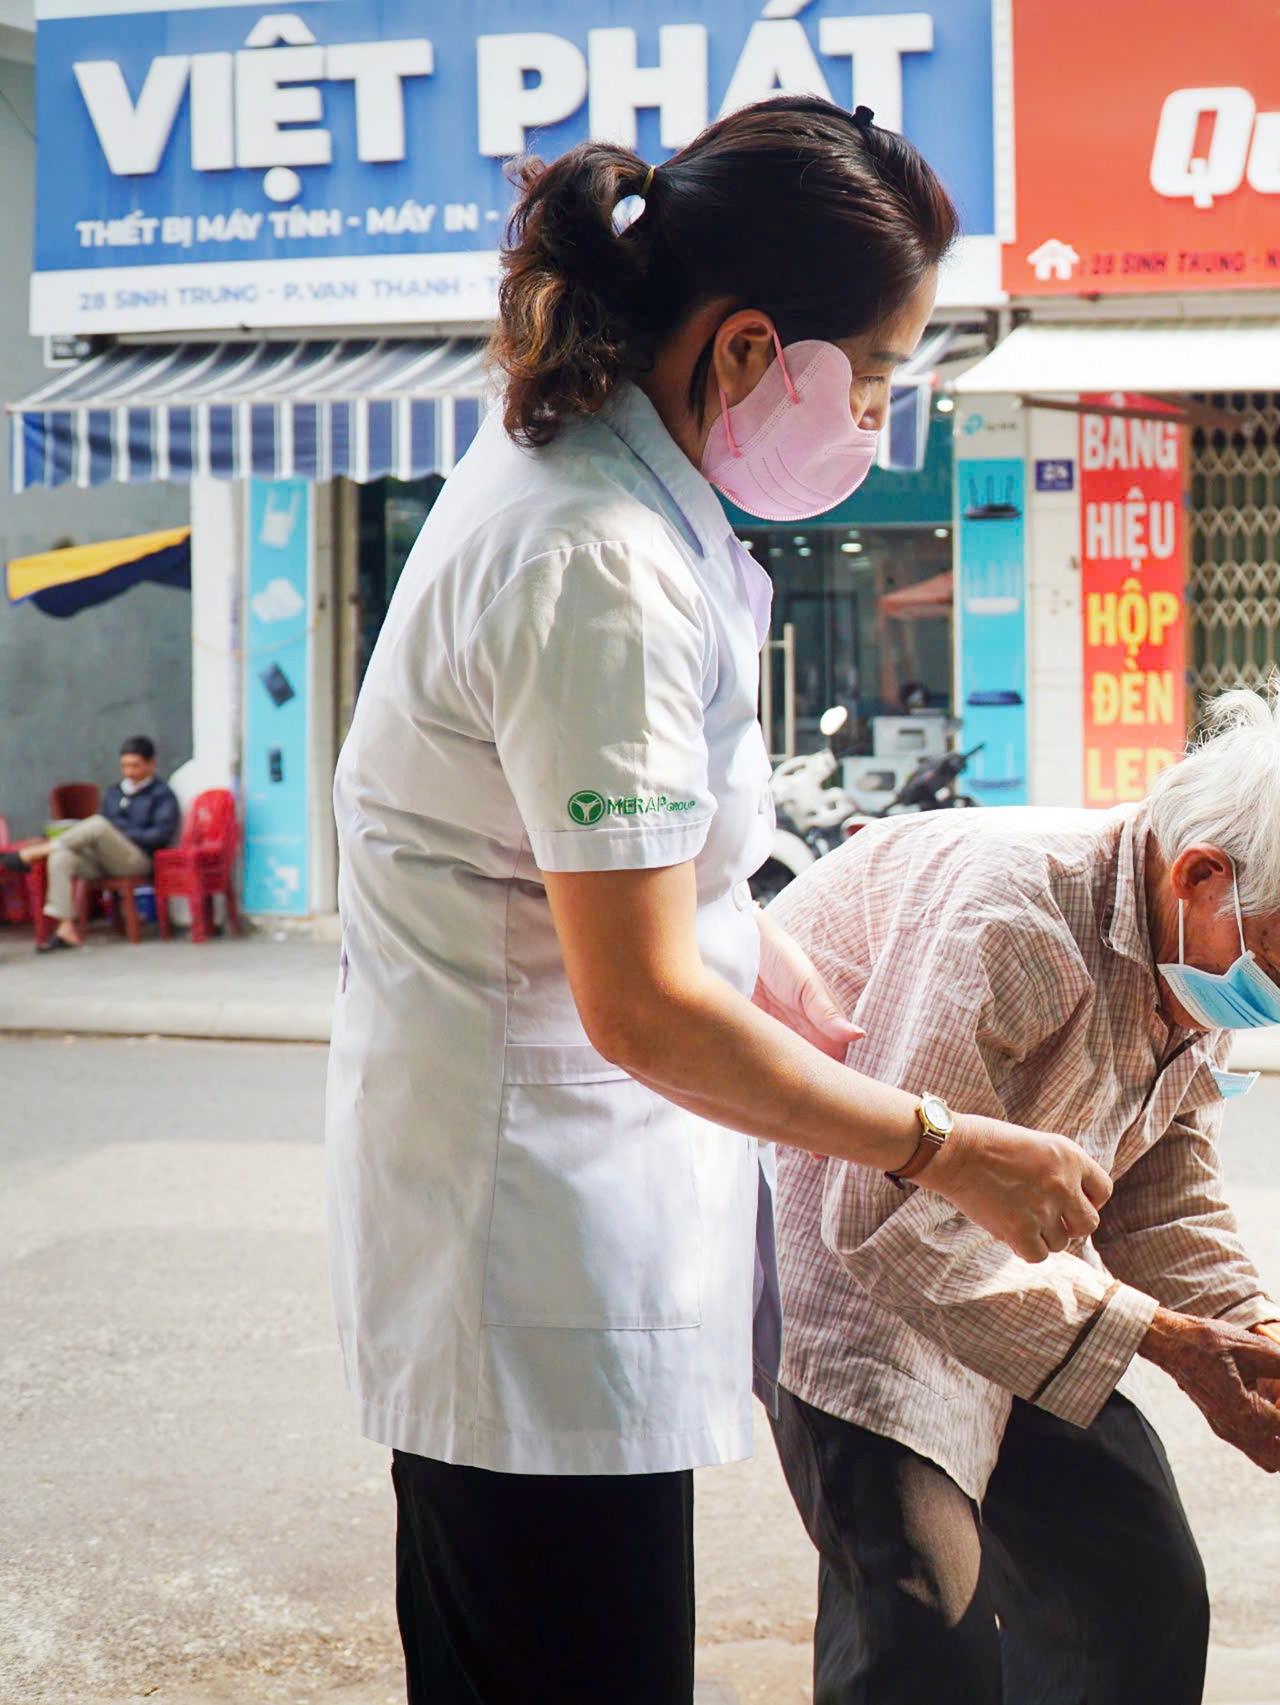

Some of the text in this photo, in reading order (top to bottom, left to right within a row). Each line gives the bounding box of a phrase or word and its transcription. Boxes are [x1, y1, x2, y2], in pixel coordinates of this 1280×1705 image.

[73, 0, 933, 203] VIỆT PHÁT
[75, 208, 160, 248] THIẾT
[197, 207, 263, 243] MÁY
[268, 204, 342, 239] TÍNH
[366, 200, 436, 236] MÁY
[443, 203, 480, 232] IN
[114, 289, 168, 310] SINH
[178, 283, 258, 306] TRUNG
[1086, 486, 1175, 572] HIỆU
[1087, 578, 1180, 656] HỘP
[1092, 656, 1175, 725] ĐÈN
[607, 795, 667, 816] MERAP
